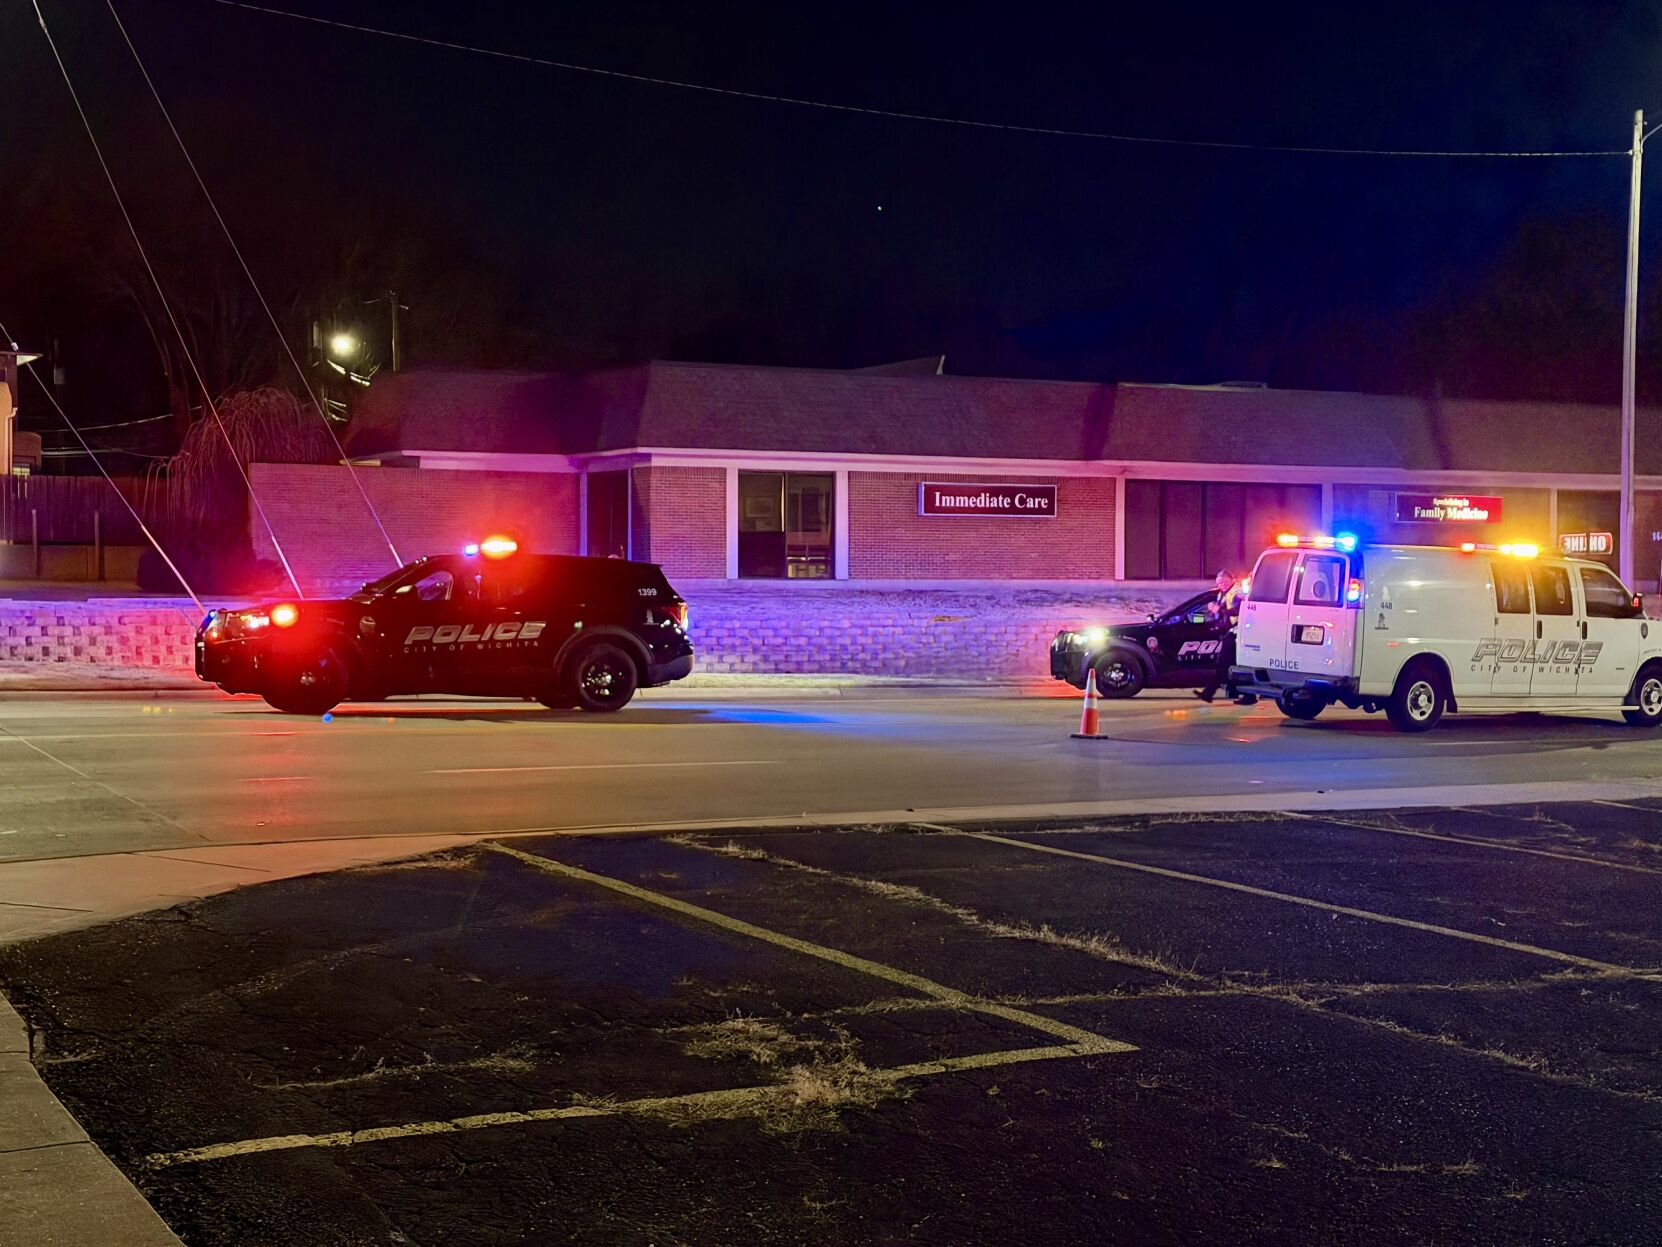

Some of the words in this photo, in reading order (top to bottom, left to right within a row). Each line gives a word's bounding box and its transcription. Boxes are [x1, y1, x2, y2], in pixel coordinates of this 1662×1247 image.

[934, 491, 1011, 508] Immediate
[1014, 493, 1049, 509] Care
[1414, 506, 1446, 521] Family
[1446, 507, 1489, 520] Medicine
[637, 588, 657, 596] 1399
[1380, 602, 1392, 610] 448
[404, 621, 546, 645] POLICE
[404, 645, 437, 653] CITY
[477, 640, 539, 650] WICHITA
[1471, 637, 1604, 664] POLICE
[1269, 658, 1300, 670] POLICE
[1471, 664, 1502, 673] CITY
[1512, 665, 1527, 673] OF
[1538, 665, 1593, 674] WICHITA
